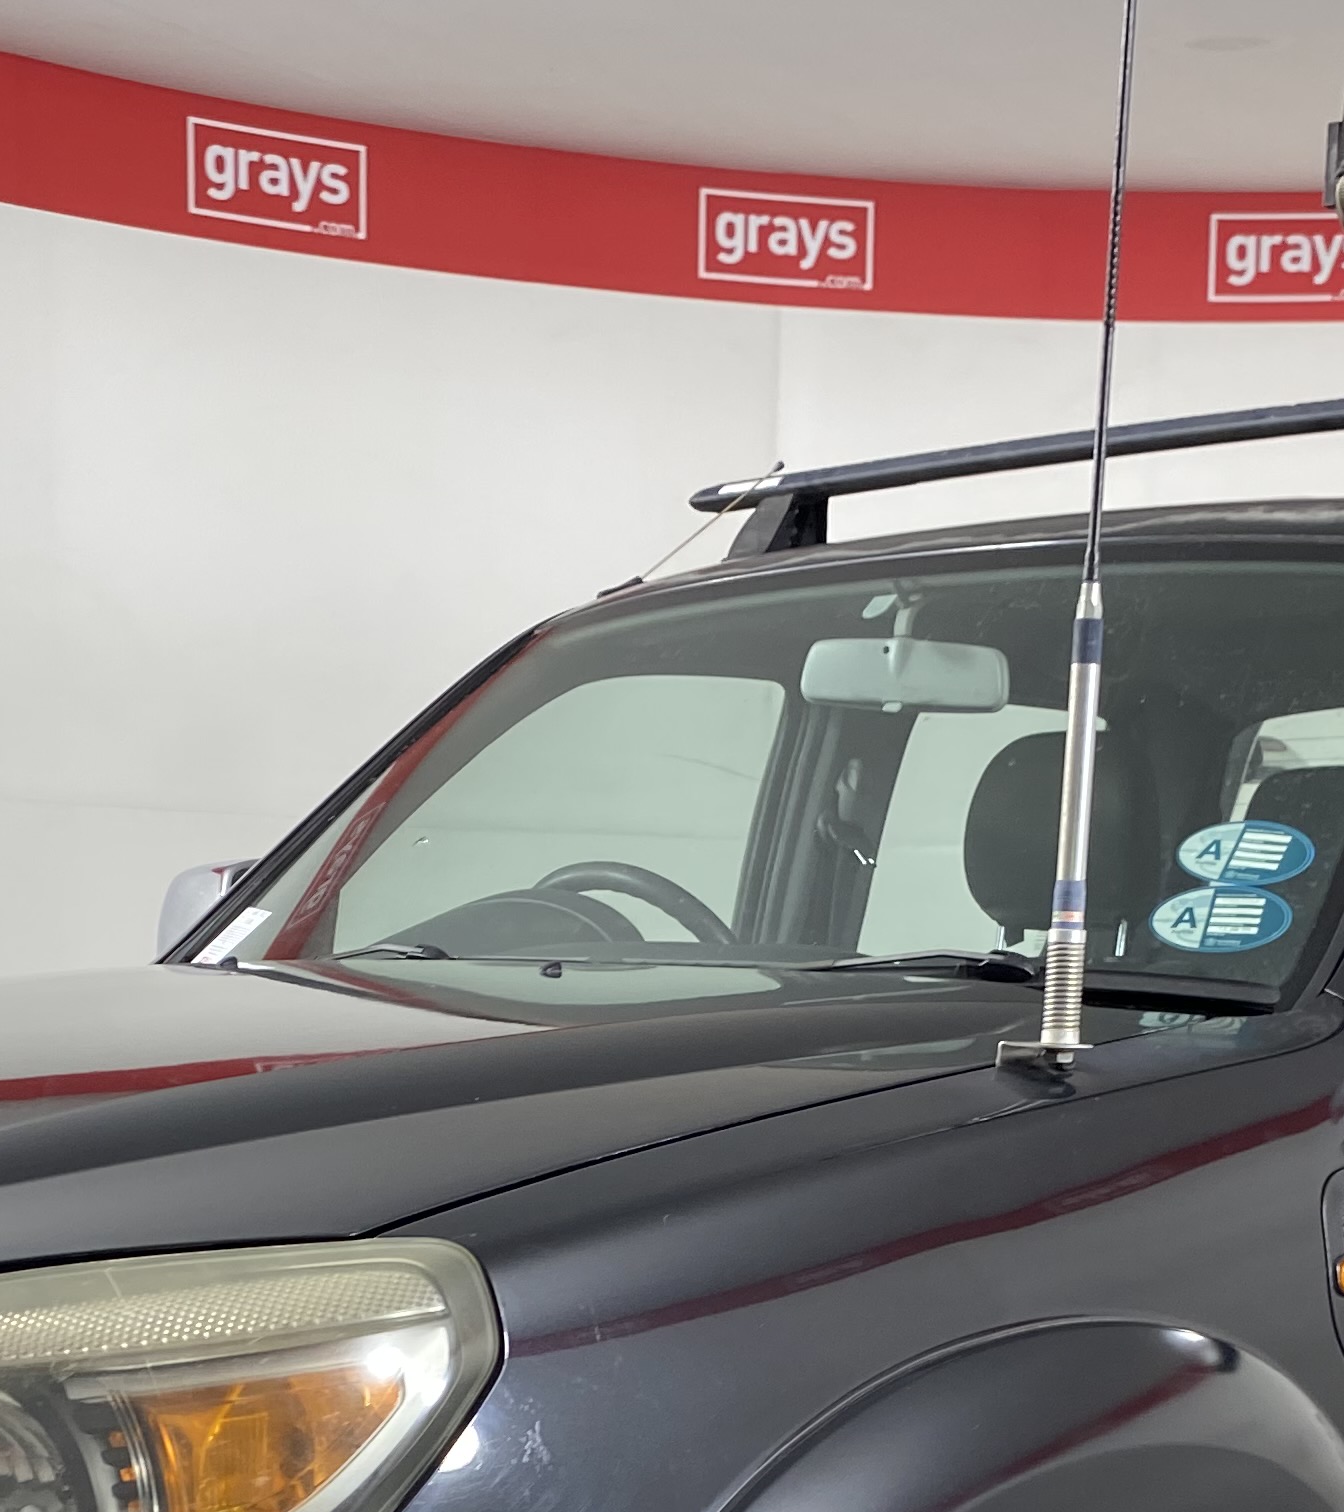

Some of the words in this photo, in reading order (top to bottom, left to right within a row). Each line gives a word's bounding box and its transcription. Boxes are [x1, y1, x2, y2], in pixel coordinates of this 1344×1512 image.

[204, 144, 350, 213] grays
[715, 211, 858, 270] grays
[1195, 838, 1223, 862] A
[1170, 906, 1198, 930] A
